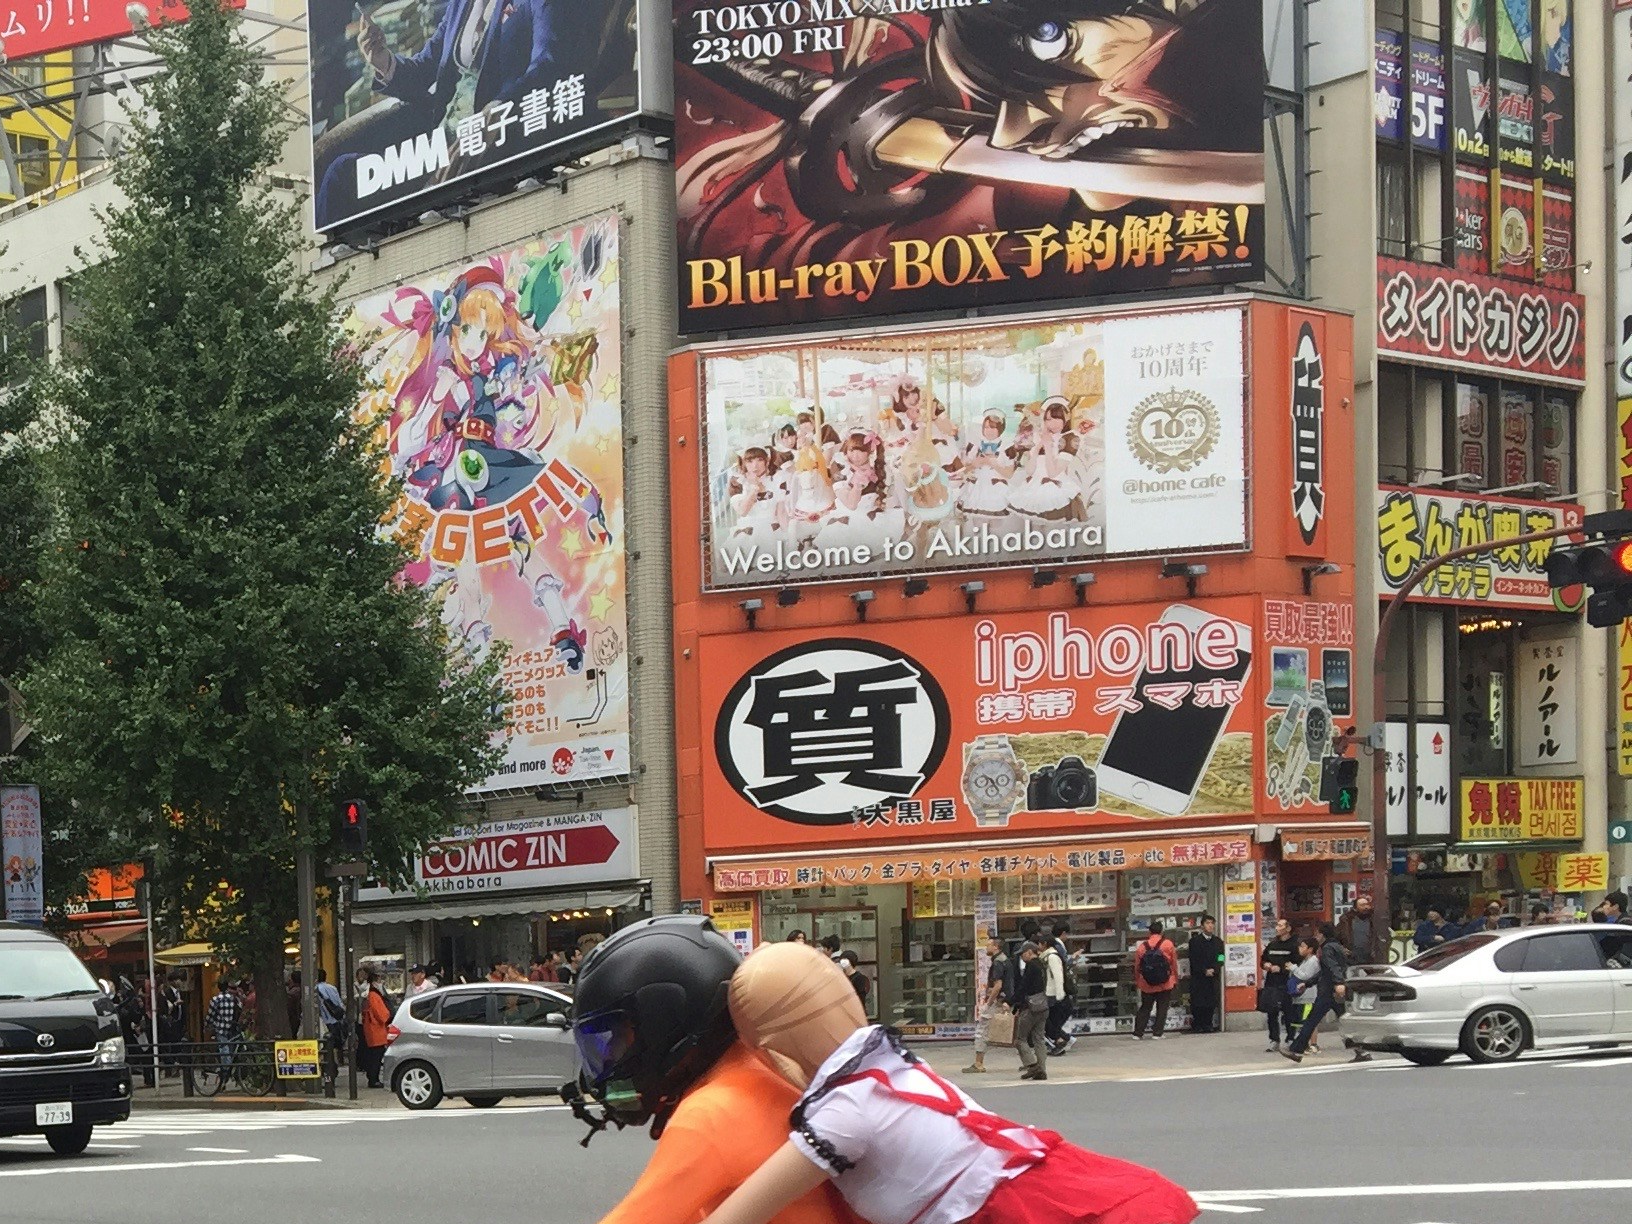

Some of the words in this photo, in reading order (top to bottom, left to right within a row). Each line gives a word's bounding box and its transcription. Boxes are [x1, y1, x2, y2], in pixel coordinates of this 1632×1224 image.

[692, 1, 802, 35] TOKYO
[692, 35, 783, 65] 23:00
[793, 25, 846, 54] FRI
[1411, 91, 1444, 140] 5F
[356, 126, 451, 199] DMM
[456, 73, 586, 158] 電子書籍
[687, 253, 884, 309] Blu-ray
[890, 231, 1009, 290] BOX
[1010, 204, 1252, 275] 予約解禁!
[1379, 270, 1580, 370] メイドカジノ
[1131, 340, 1214, 358] おかげさまで
[1139, 356, 1208, 379] 10周年
[1149, 418, 1185, 440] 10
[1122, 476, 1187, 495] @home
[1190, 472, 1227, 490] cafe
[720, 538, 872, 576] Welcome
[882, 534, 914, 562] to
[925, 520, 1104, 560] Akihabara
[1263, 600, 1354, 647] 買取最強!!
[975, 612, 1241, 692] iphone
[506, 684, 546, 702] るのも
[977, 688, 1077, 724] 携帯
[1094, 678, 1244, 715] スマホ
[1538, 662, 1562, 758] ルノアール
[743, 659, 923, 808] 質
[519, 760, 547, 774] more
[863, 797, 958, 827] 大黒屋
[1468, 781, 1523, 827] 免税
[1528, 781, 1549, 811] TAX
[1550, 781, 1576, 811] FREE
[494, 823, 505, 833] for
[506, 818, 545, 833] Magazine
[1529, 812, 1577, 838] 면세점
[424, 839, 518, 876] COMIC
[525, 833, 567, 867] ZIN
[718, 868, 790, 889] 高価買取
[1170, 841, 1248, 863] 無料査定
[1564, 856, 1604, 888] 薬
[424, 876, 502, 893] Akihabara
